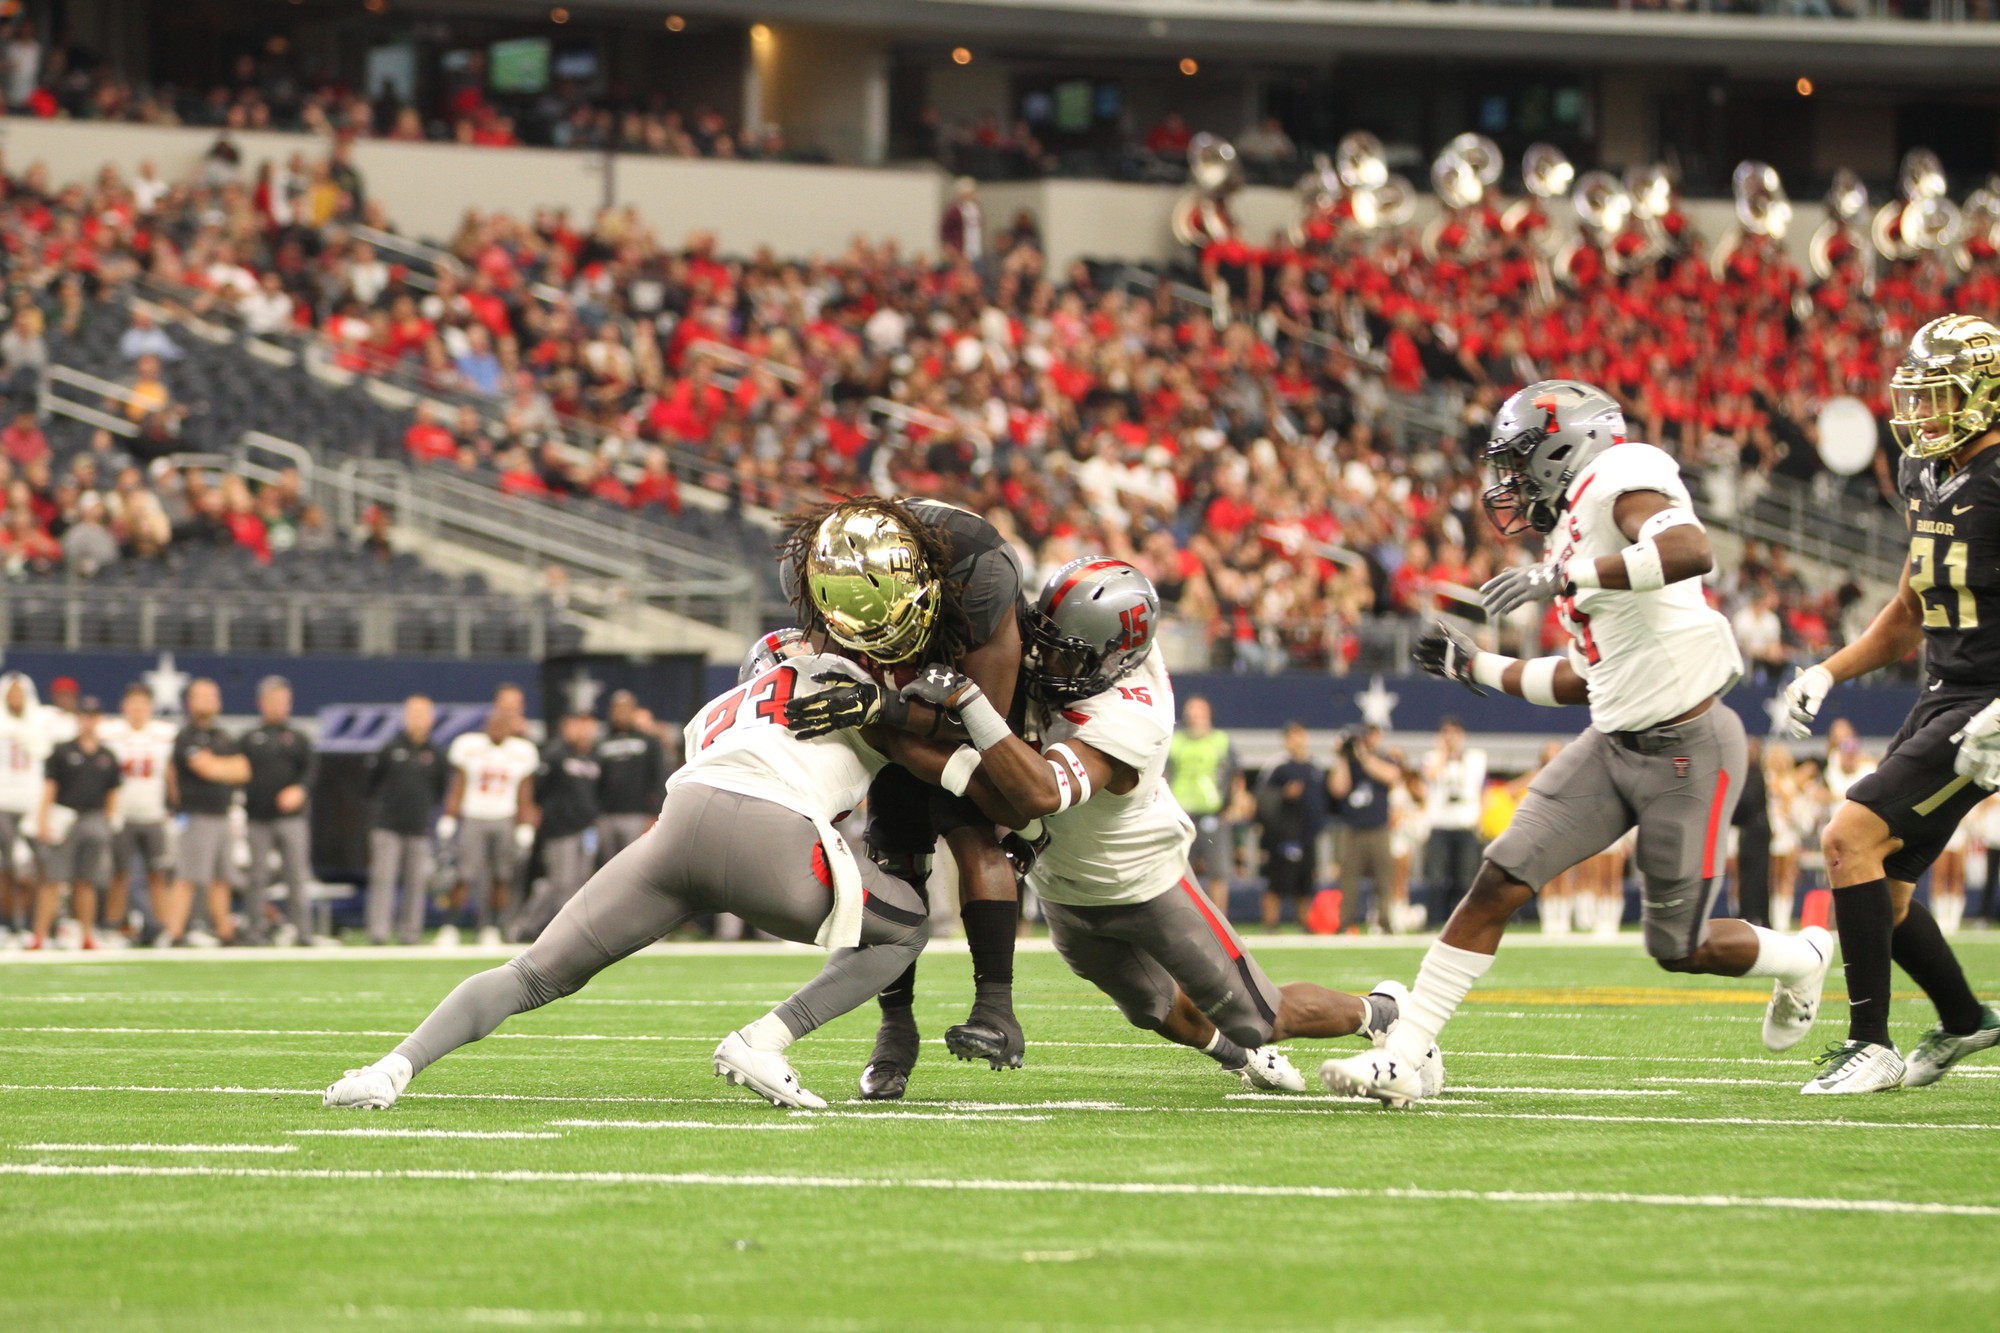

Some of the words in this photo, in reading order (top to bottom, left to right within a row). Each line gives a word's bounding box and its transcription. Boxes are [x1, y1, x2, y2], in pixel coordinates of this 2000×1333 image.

[1916, 519, 1955, 536] BLOR
[1909, 536, 1979, 627] 21
[1119, 603, 1149, 651] 15
[1118, 686, 1153, 707] 15
